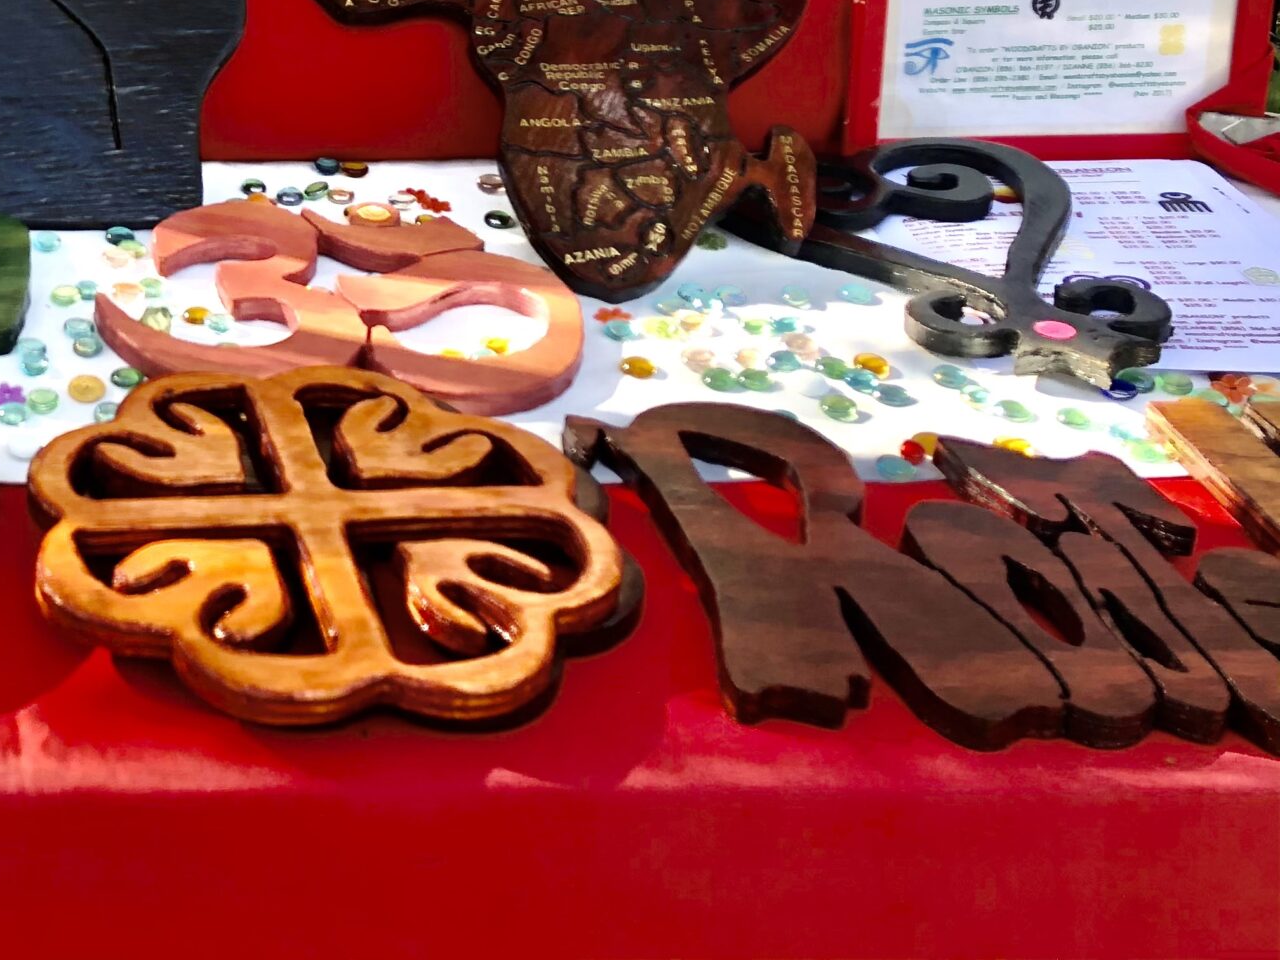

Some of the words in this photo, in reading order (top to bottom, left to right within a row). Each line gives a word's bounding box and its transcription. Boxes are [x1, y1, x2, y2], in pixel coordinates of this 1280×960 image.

[514, 28, 543, 65] CONGO
[740, 25, 791, 62] SOMALIA
[558, 81, 607, 92] Congo
[519, 118, 582, 128] ANGOLA
[779, 136, 804, 238] MADAGASCAR
[564, 246, 621, 266] AZANIA
